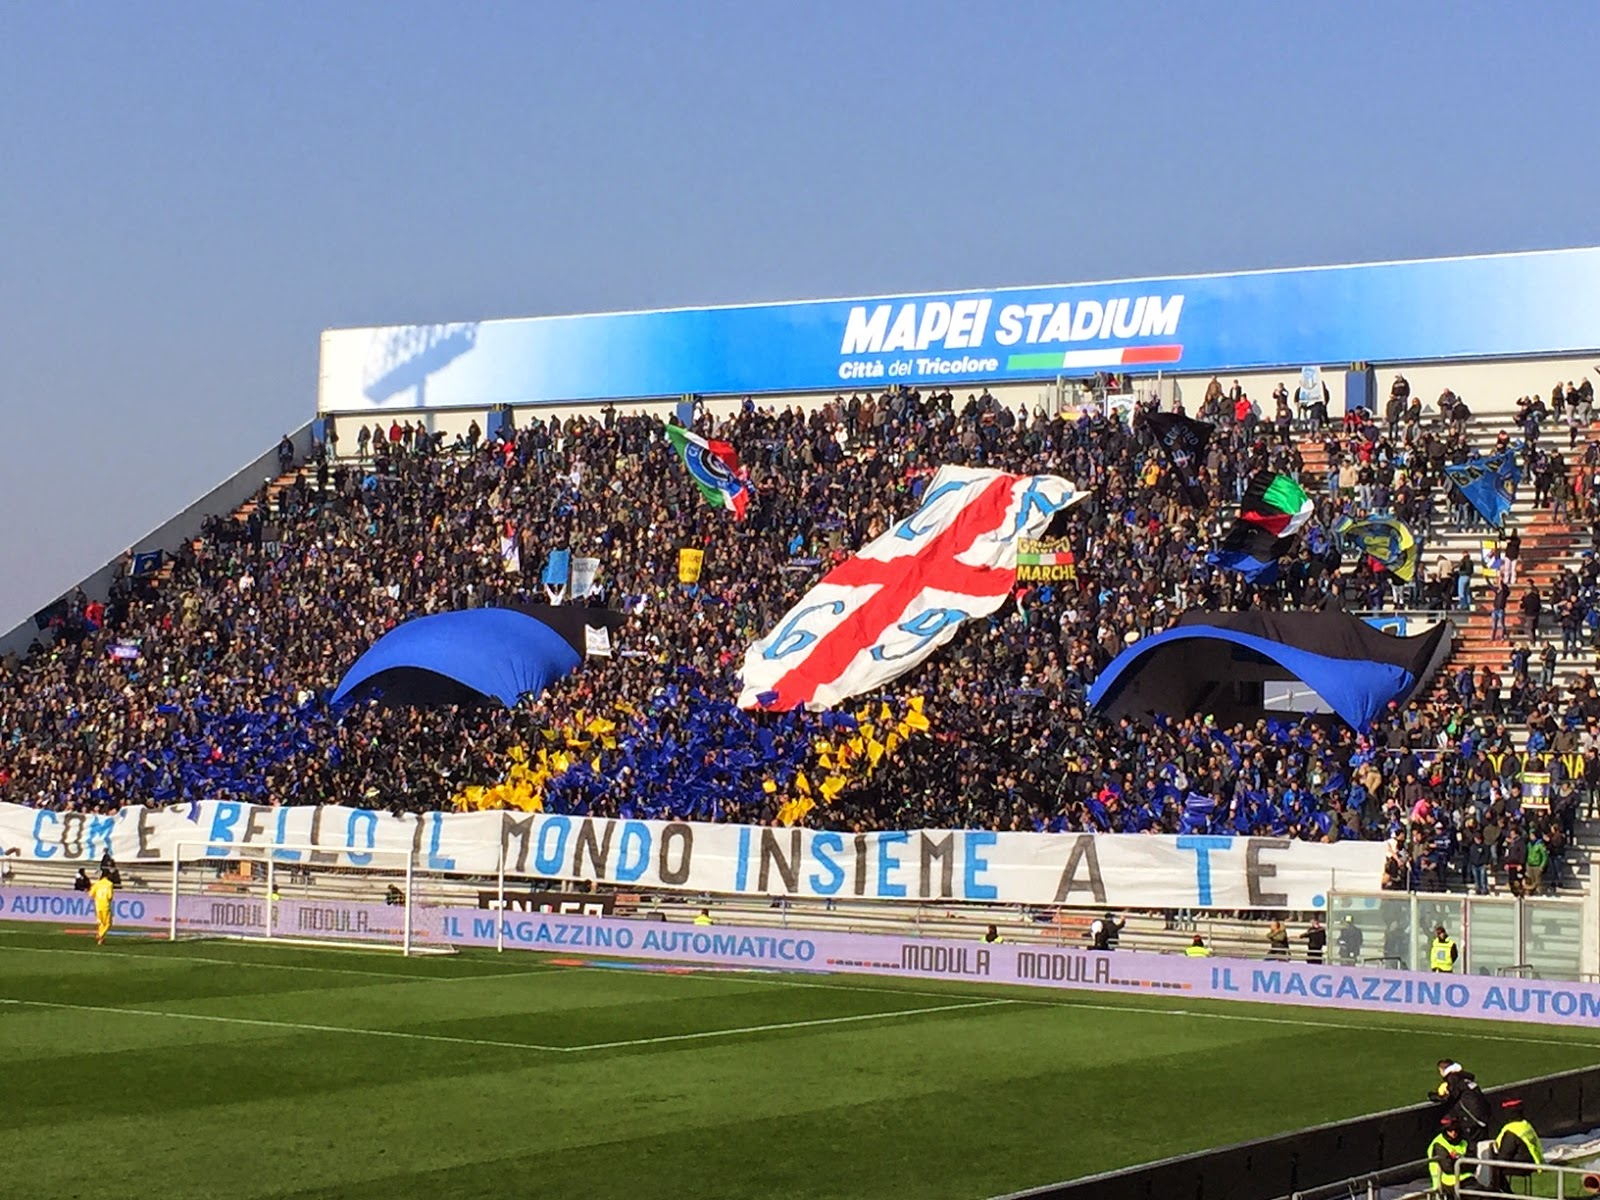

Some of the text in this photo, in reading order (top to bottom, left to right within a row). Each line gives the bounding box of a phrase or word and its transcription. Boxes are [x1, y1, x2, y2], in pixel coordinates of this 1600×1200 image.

[841, 295, 1184, 354] MAPEI STADIUM
[838, 356, 998, 379] Città del Tricolore
[1017, 565, 1076, 580] MARCHE
[205, 801, 379, 866] BELLO
[412, 811, 456, 870] IL
[497, 812, 694, 884] MONDO
[735, 827, 996, 900] INSIEME
[1053, 834, 1108, 903] A
[11, 895, 145, 919] AUTOMAICO
[300, 906, 368, 933] MODULA
[443, 916, 816, 962] IL MAGAZZINO AUTOMATICO
[902, 944, 1110, 985] MODULA MODULA
[1211, 967, 1239, 991] IL
[1252, 969, 1470, 1008] MAGAZZINO
